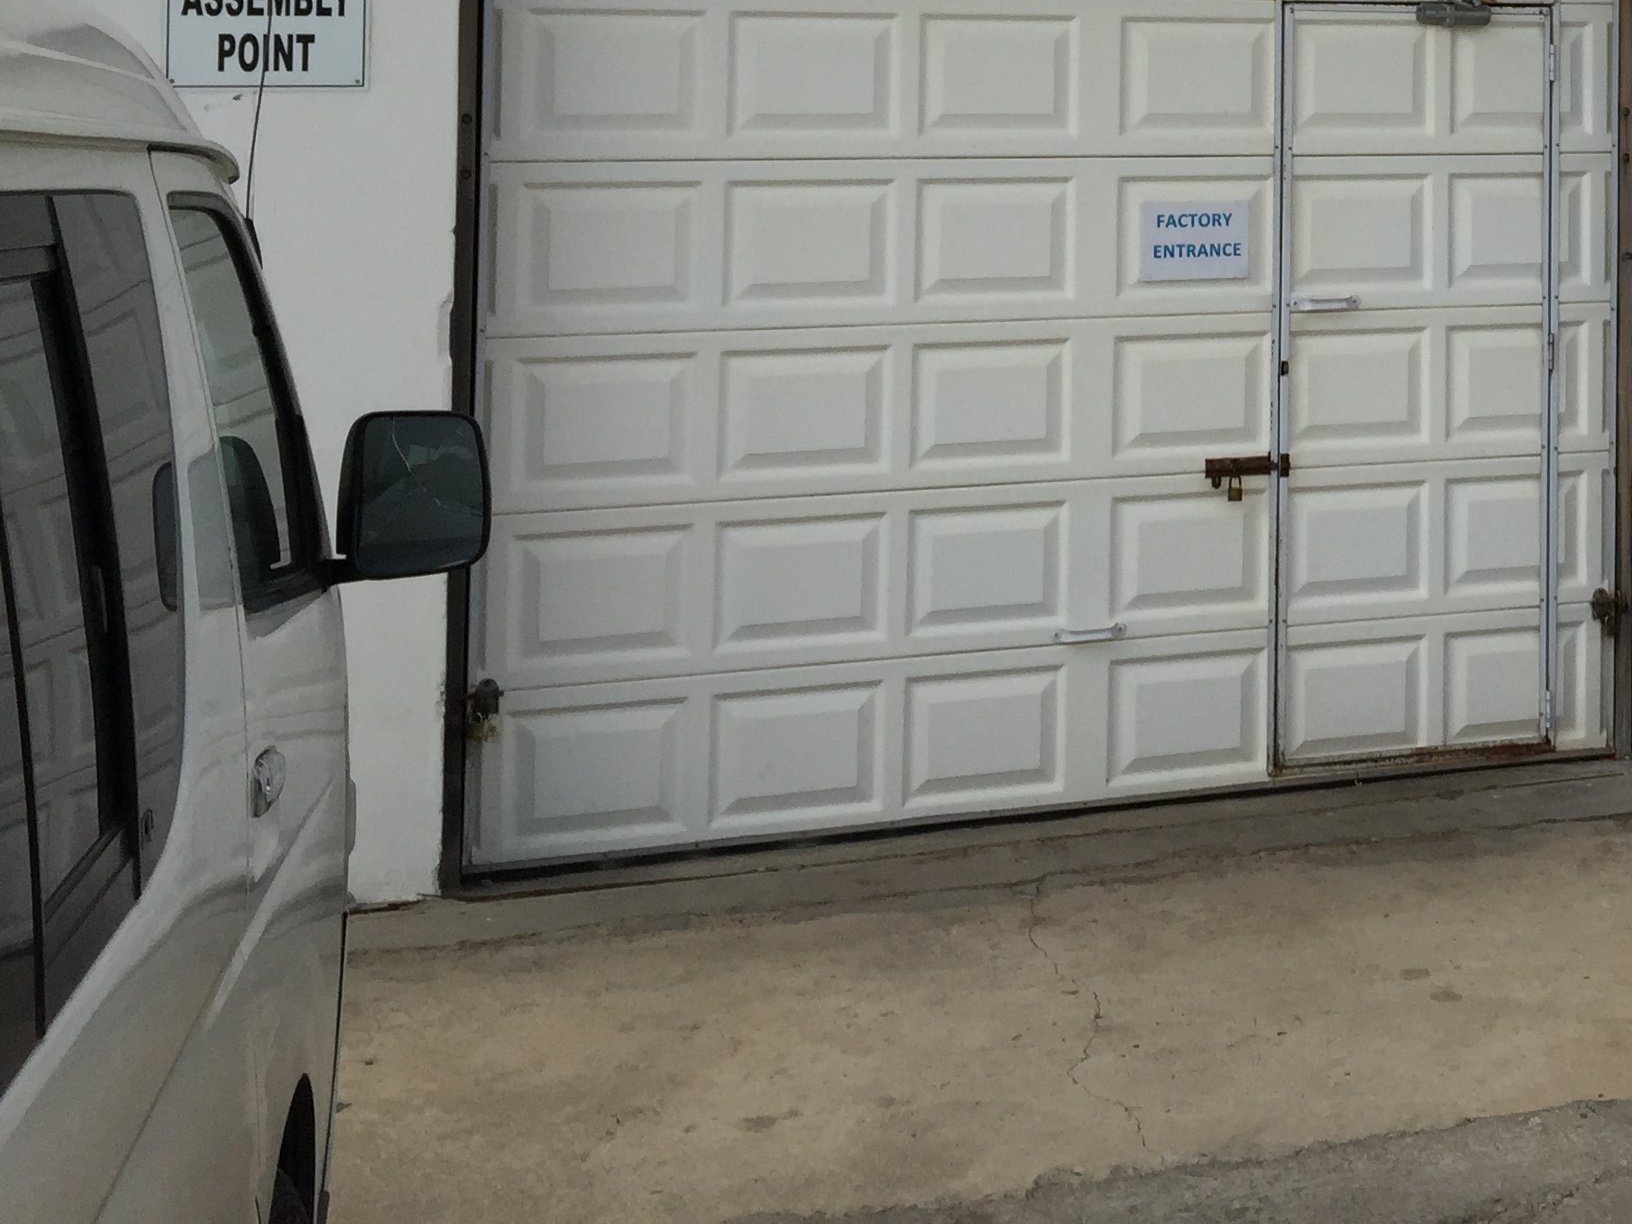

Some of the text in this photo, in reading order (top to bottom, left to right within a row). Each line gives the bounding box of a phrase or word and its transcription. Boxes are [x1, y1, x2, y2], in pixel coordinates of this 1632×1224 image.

[217, 32, 316, 72] POINT
[1156, 212, 1233, 228] FACTORY
[1153, 242, 1242, 259] ENTRANCE
